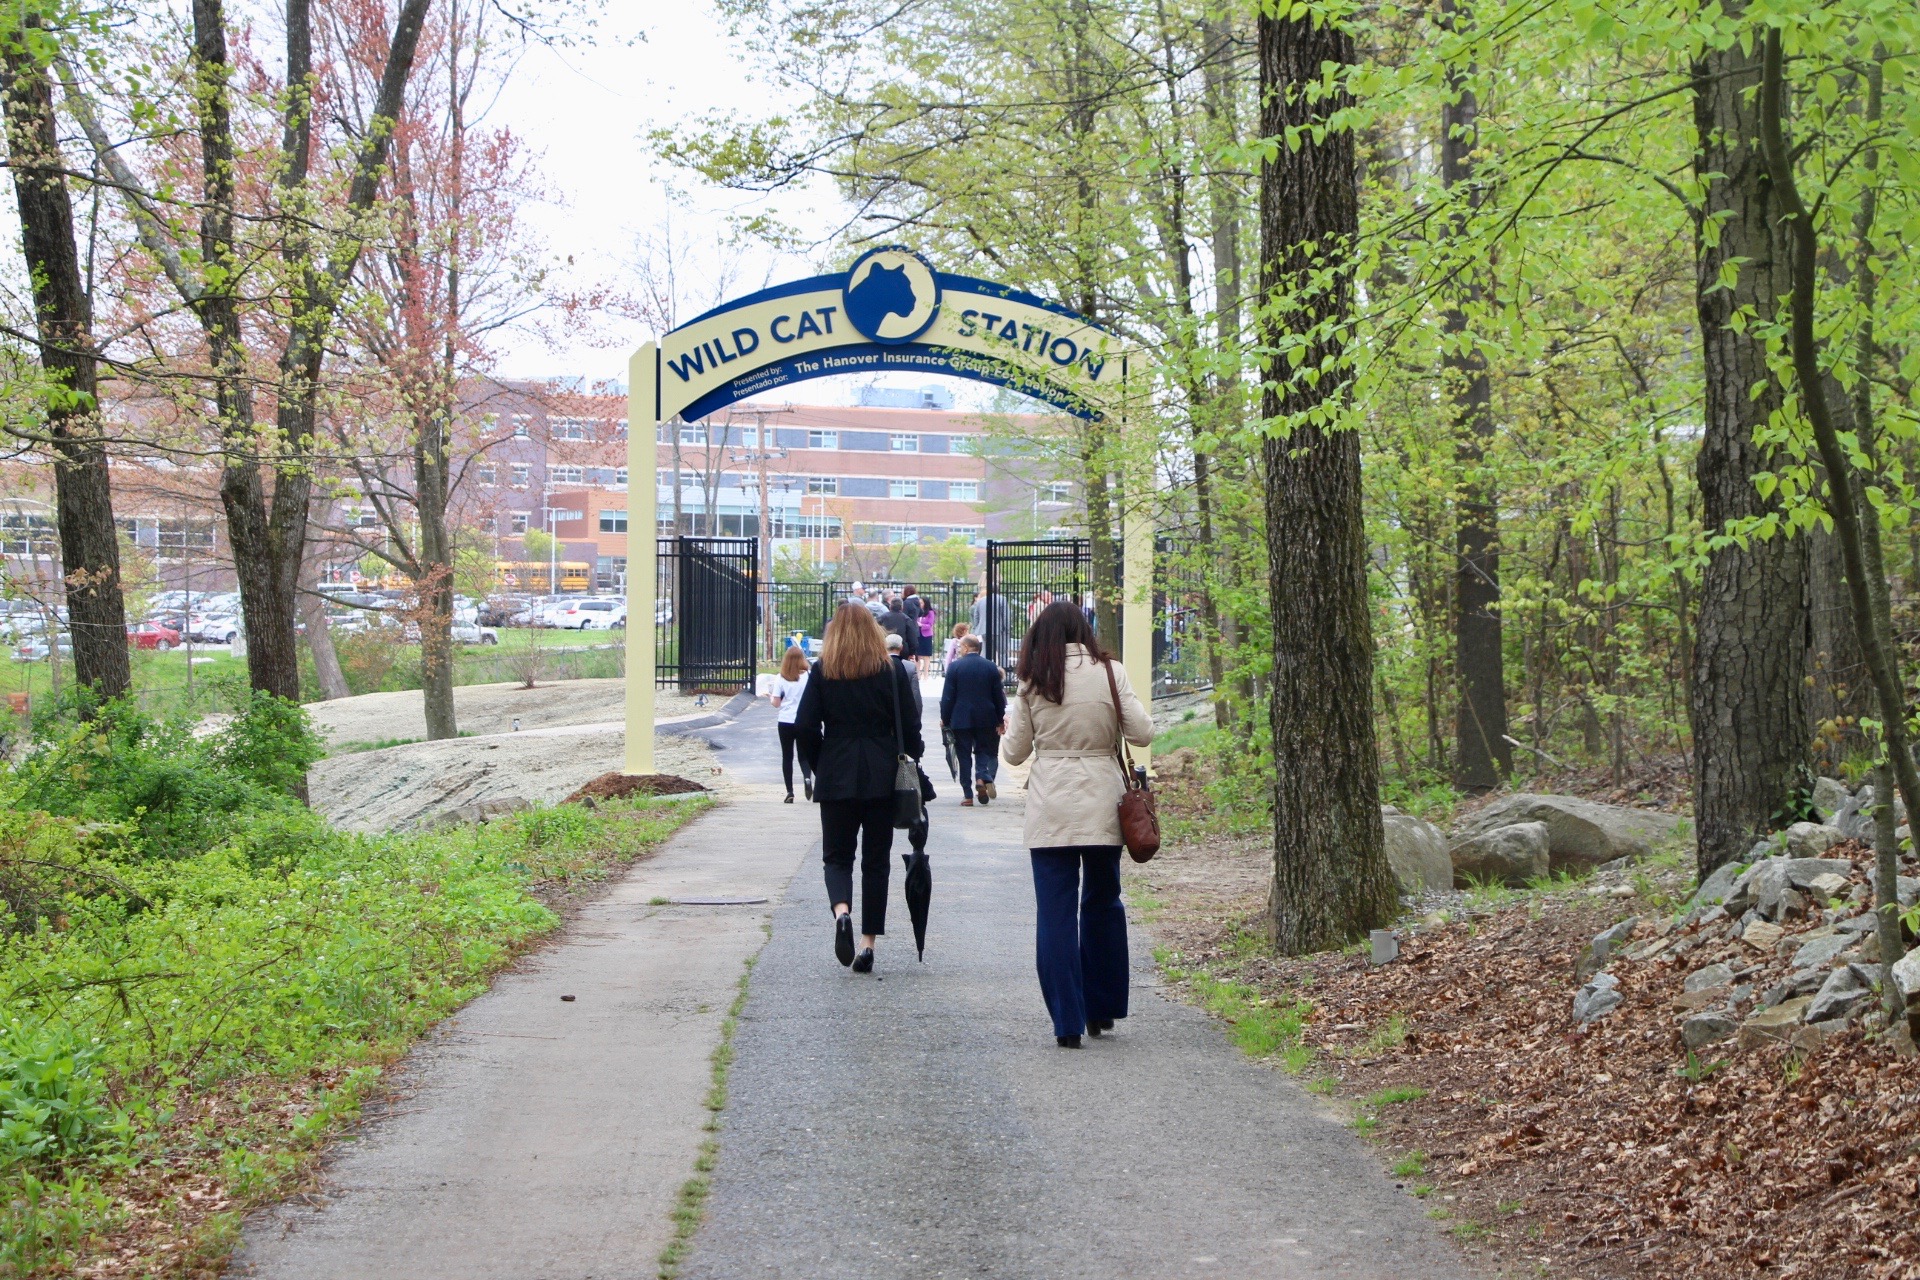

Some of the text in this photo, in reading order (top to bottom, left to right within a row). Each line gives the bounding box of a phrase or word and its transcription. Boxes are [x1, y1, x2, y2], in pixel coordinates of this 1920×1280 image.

[667, 306, 837, 382] WILD CAT
[957, 309, 1105, 381] STATION
[794, 360, 820, 374] The
[822, 354, 879, 369] Hanover
[883, 352, 945, 366] Insurance
[732, 374, 789, 398] Presentado por:
[733, 365, 783, 388] Presented by:
